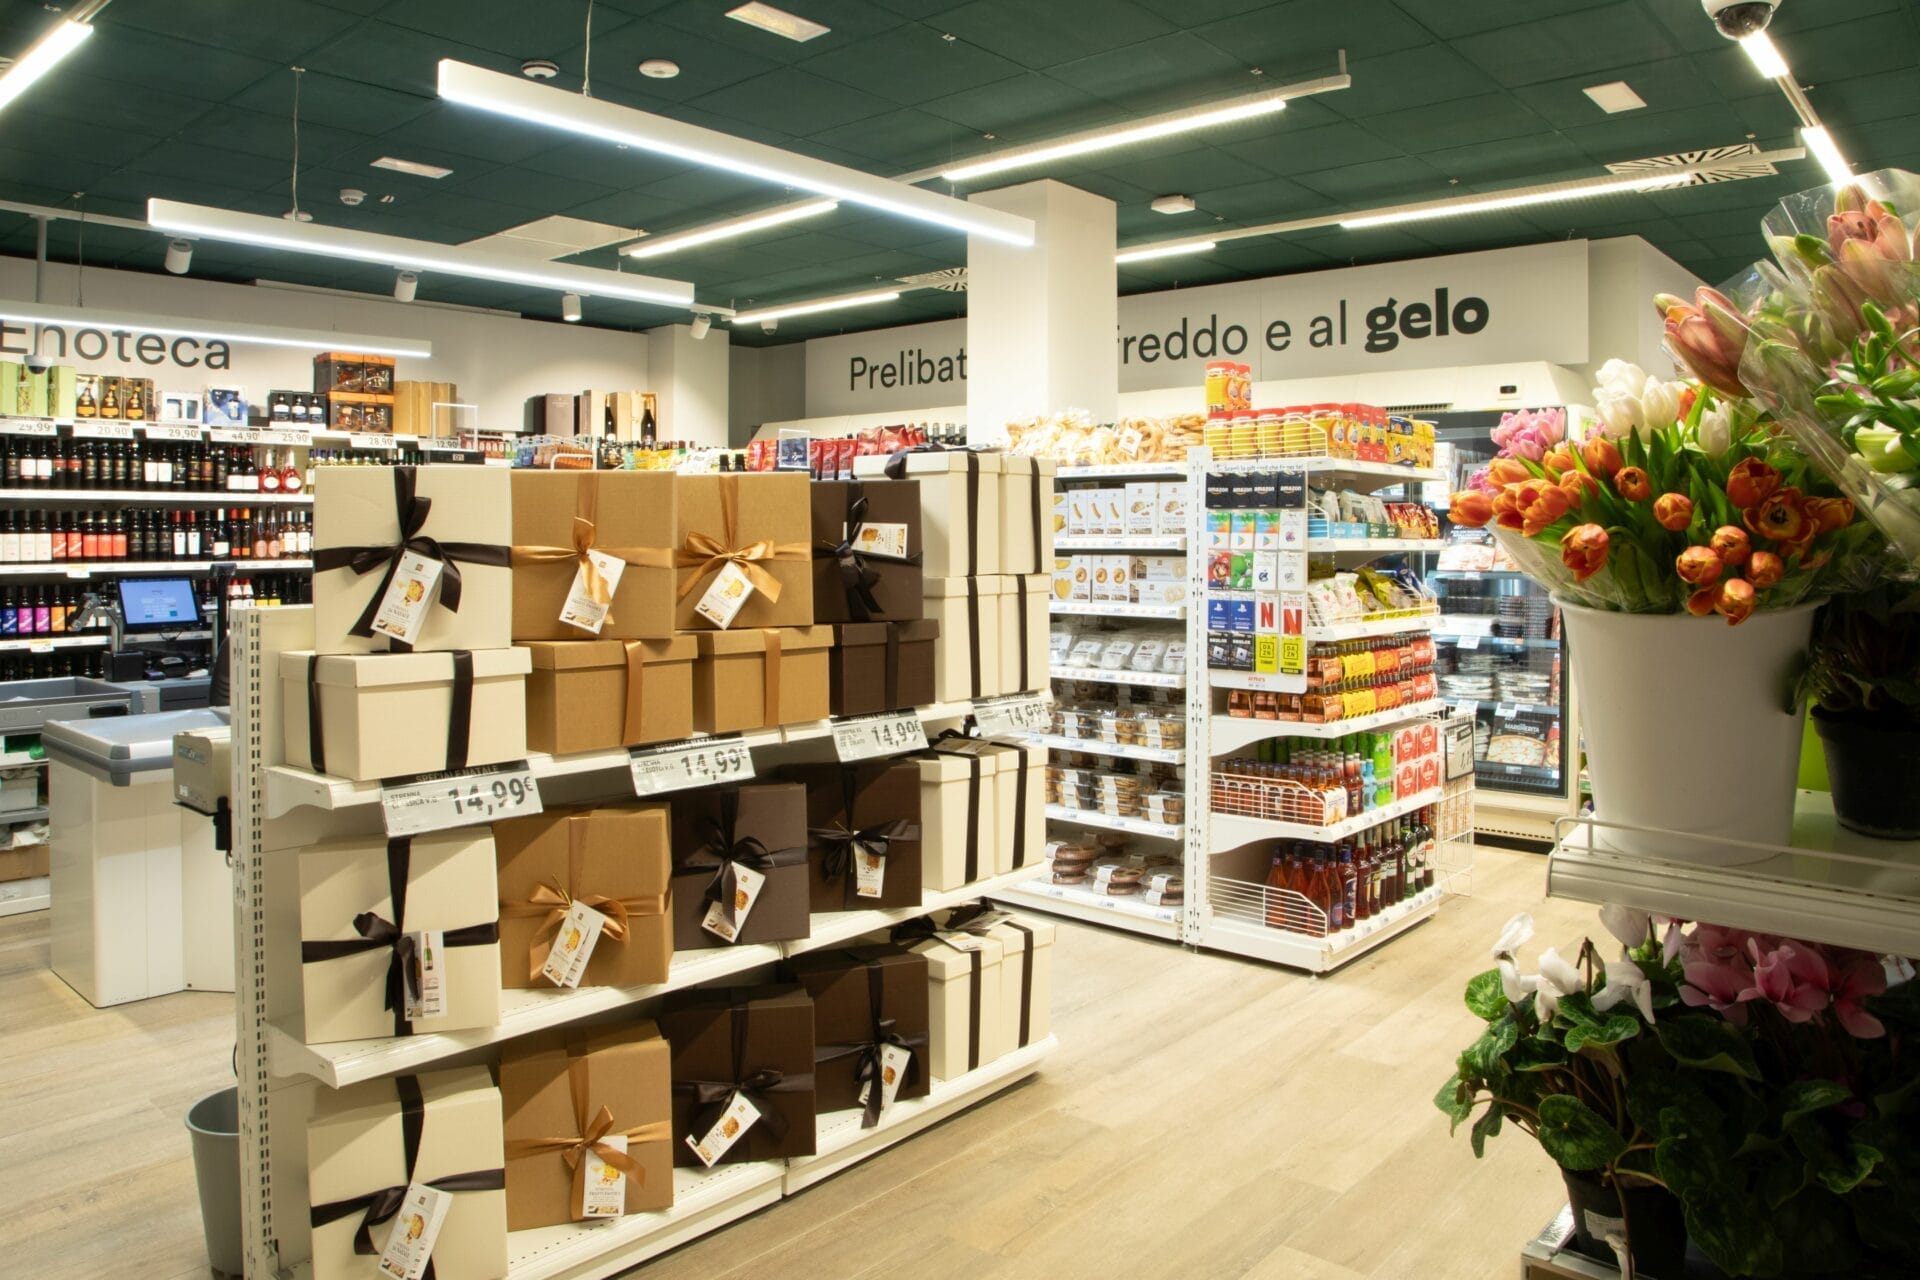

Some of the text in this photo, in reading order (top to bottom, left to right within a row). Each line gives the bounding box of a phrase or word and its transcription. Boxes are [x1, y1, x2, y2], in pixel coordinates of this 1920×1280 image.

[0, 322, 230, 370] Enoteca
[1117, 287, 1489, 364] reddo e al gelo
[448, 776, 534, 816] 14,99€
